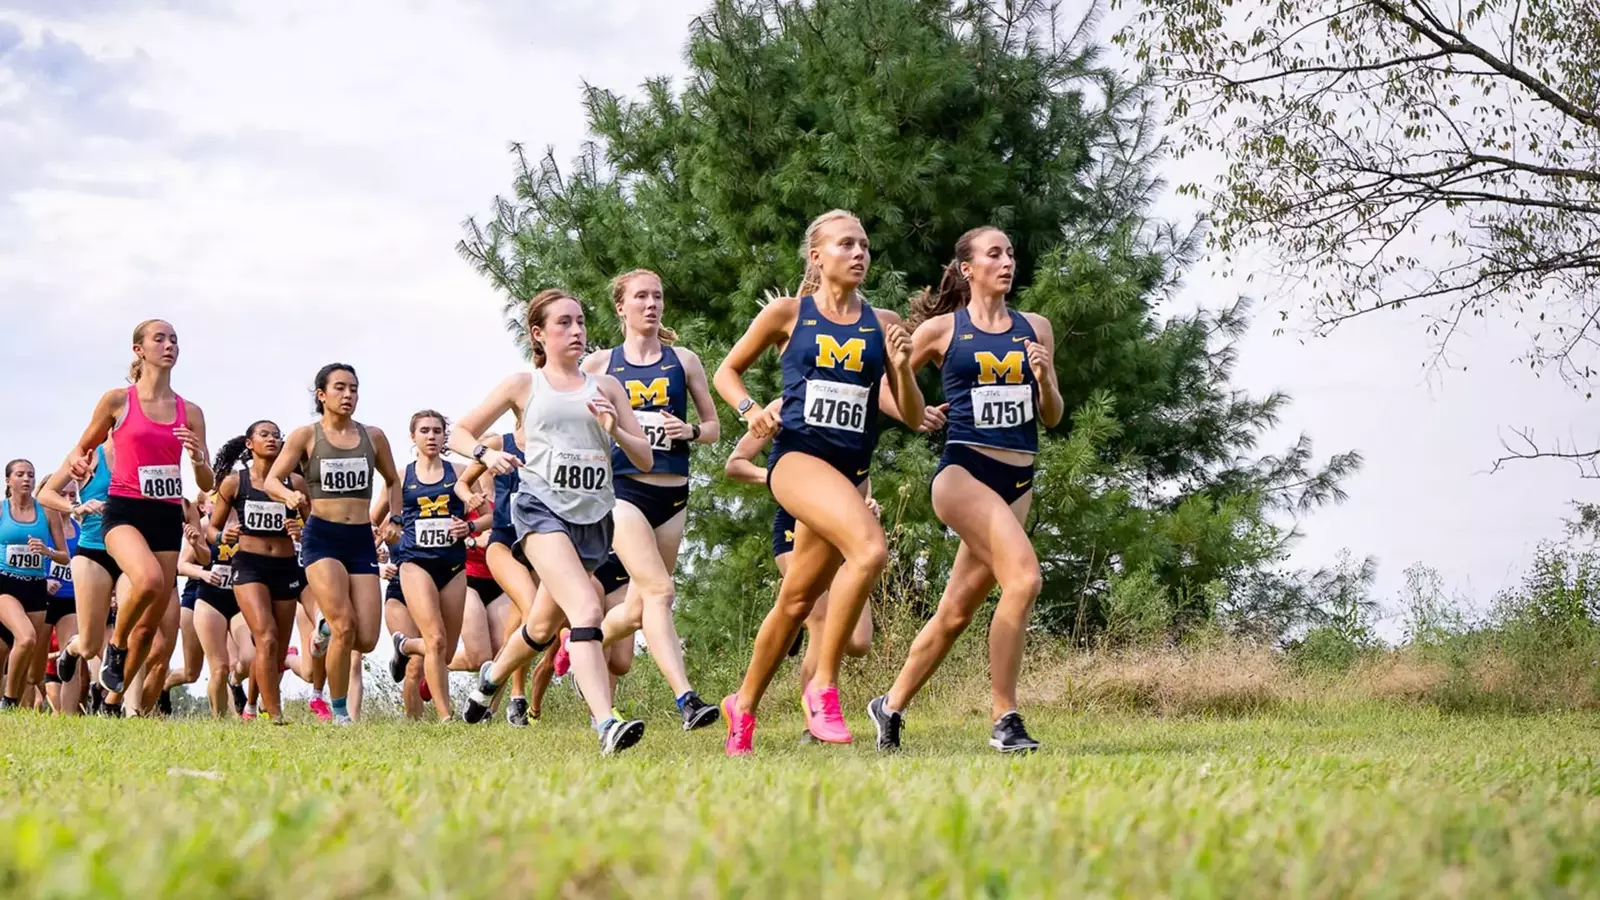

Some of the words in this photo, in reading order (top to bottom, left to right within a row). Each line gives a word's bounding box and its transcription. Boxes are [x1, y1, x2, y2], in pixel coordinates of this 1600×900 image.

[816, 334, 866, 372] M
[974, 351, 1025, 385] M
[624, 377, 670, 407] M
[809, 398, 863, 429] 4766
[981, 401, 1026, 425] 4751
[640, 424, 667, 448] 52
[143, 477, 182, 497] 4803
[323, 470, 366, 490] 4804
[553, 464, 606, 491] 4802
[417, 494, 450, 517] M
[247, 511, 283, 529] 4788
[419, 529, 454, 545] 4754
[9, 553, 40, 567] 4790
[217, 543, 240, 561] M
[52, 565, 72, 580] 478
